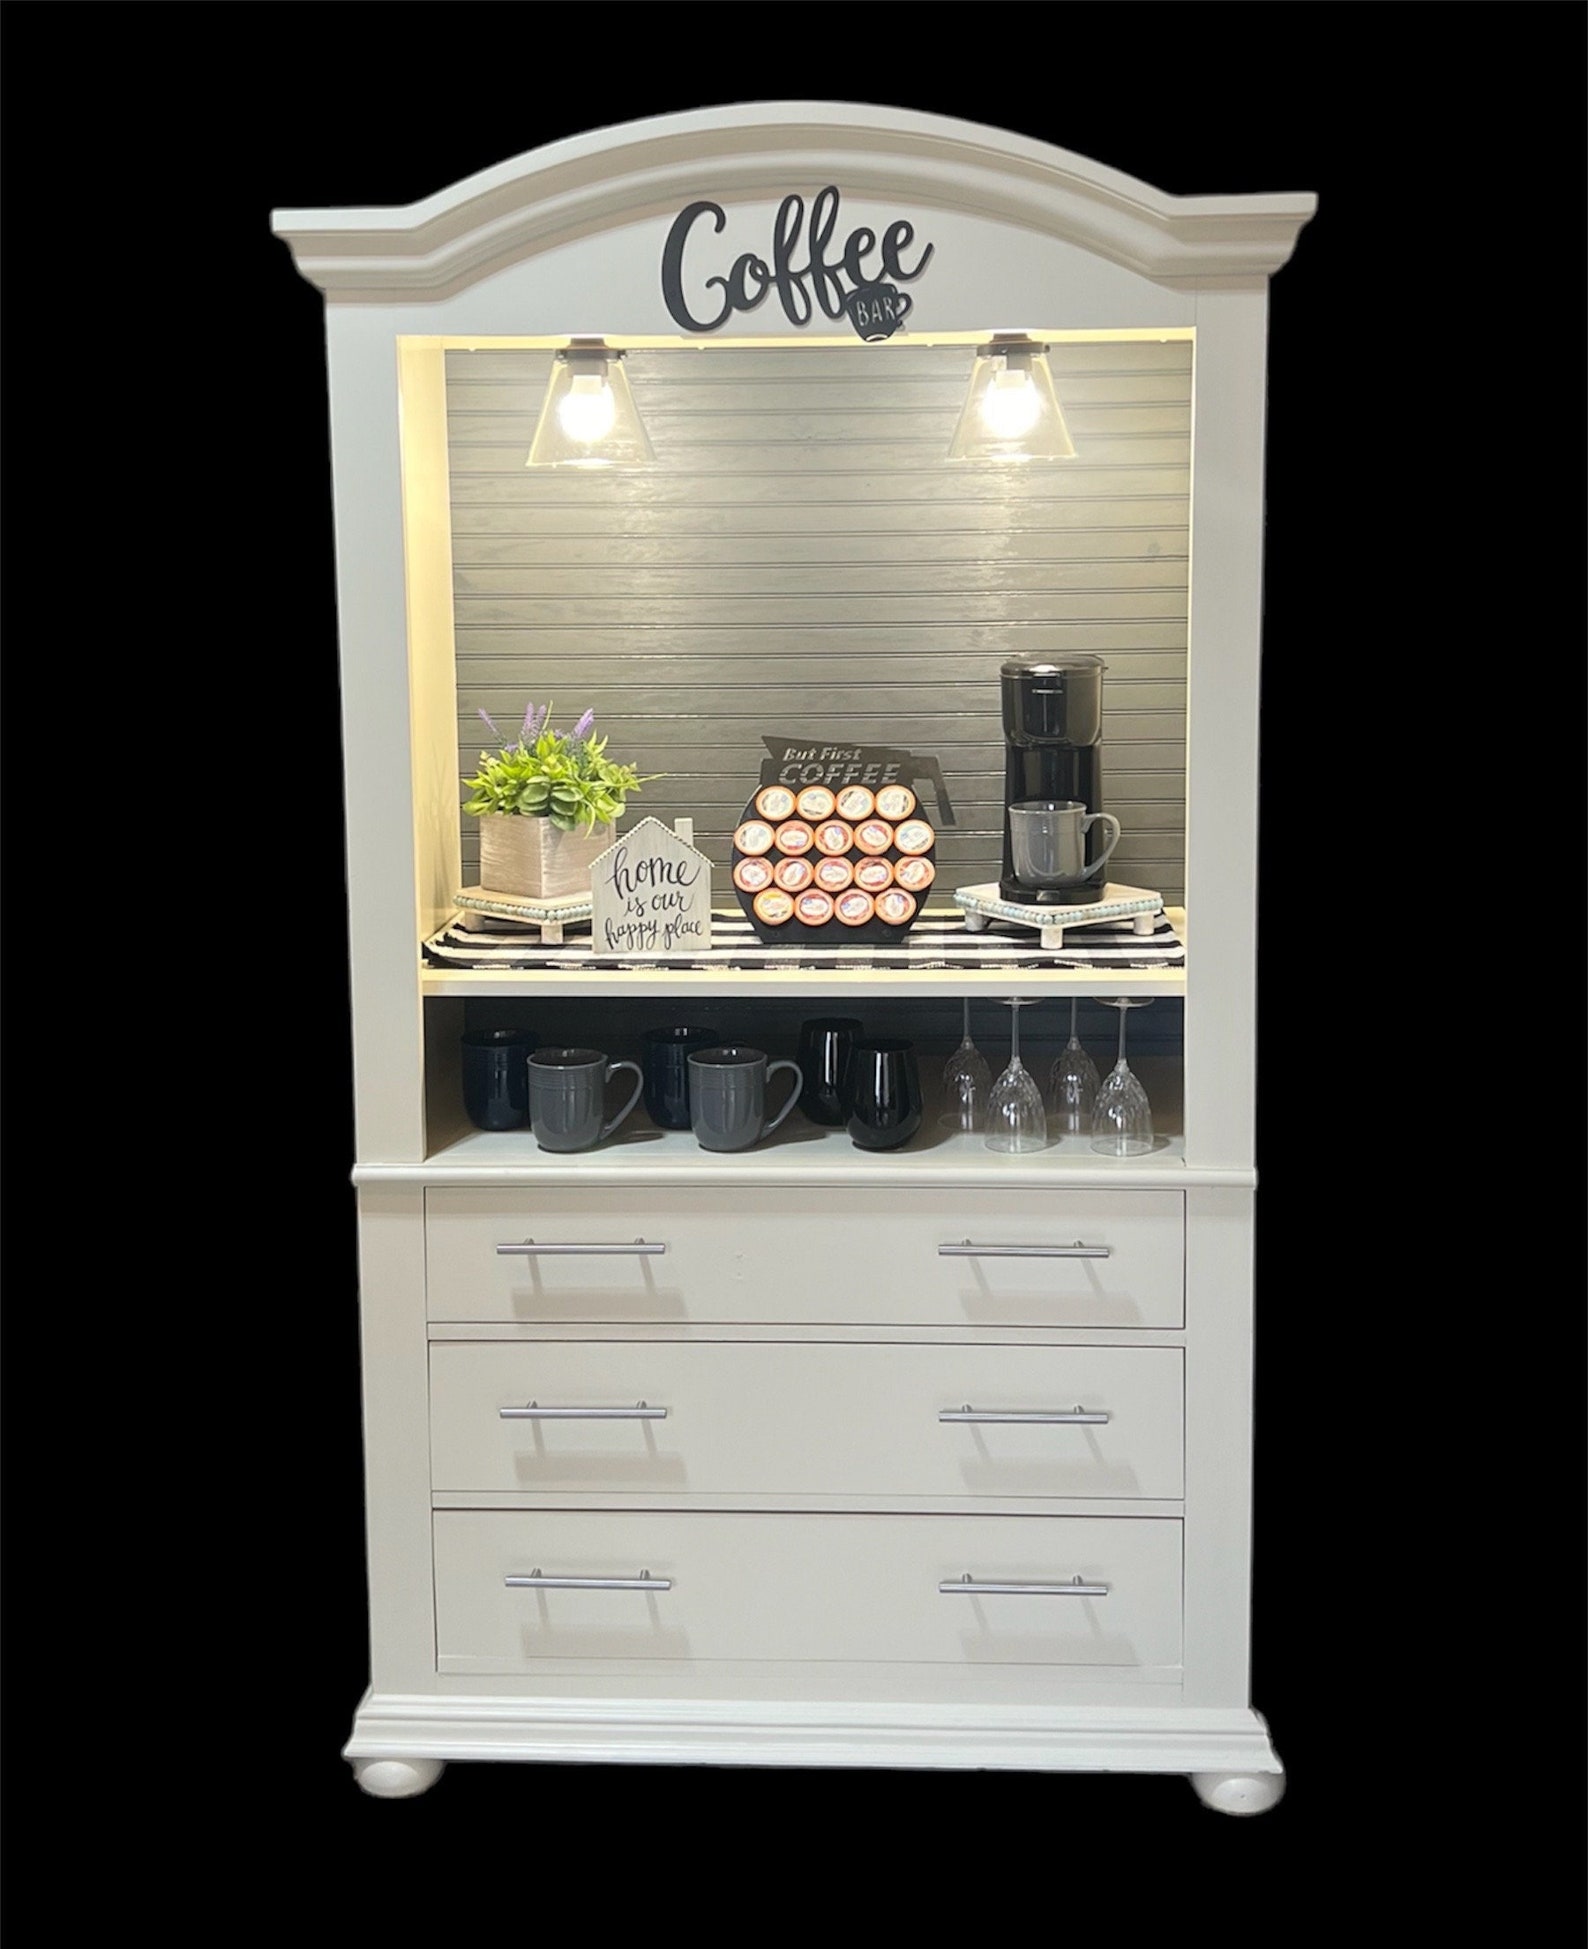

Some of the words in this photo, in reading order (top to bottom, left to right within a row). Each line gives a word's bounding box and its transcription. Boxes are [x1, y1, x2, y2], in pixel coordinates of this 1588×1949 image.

[661, 185, 933, 331] Coffee
[856, 297, 896, 326] BAR
[782, 748, 817, 761] But
[820, 747, 862, 760] First
[778, 763, 899, 785] COFFEE
[605, 846, 702, 899] home
[624, 896, 647, 917] is
[651, 891, 695, 912] our
[604, 917, 659, 950] happy
[661, 913, 703, 950] place
